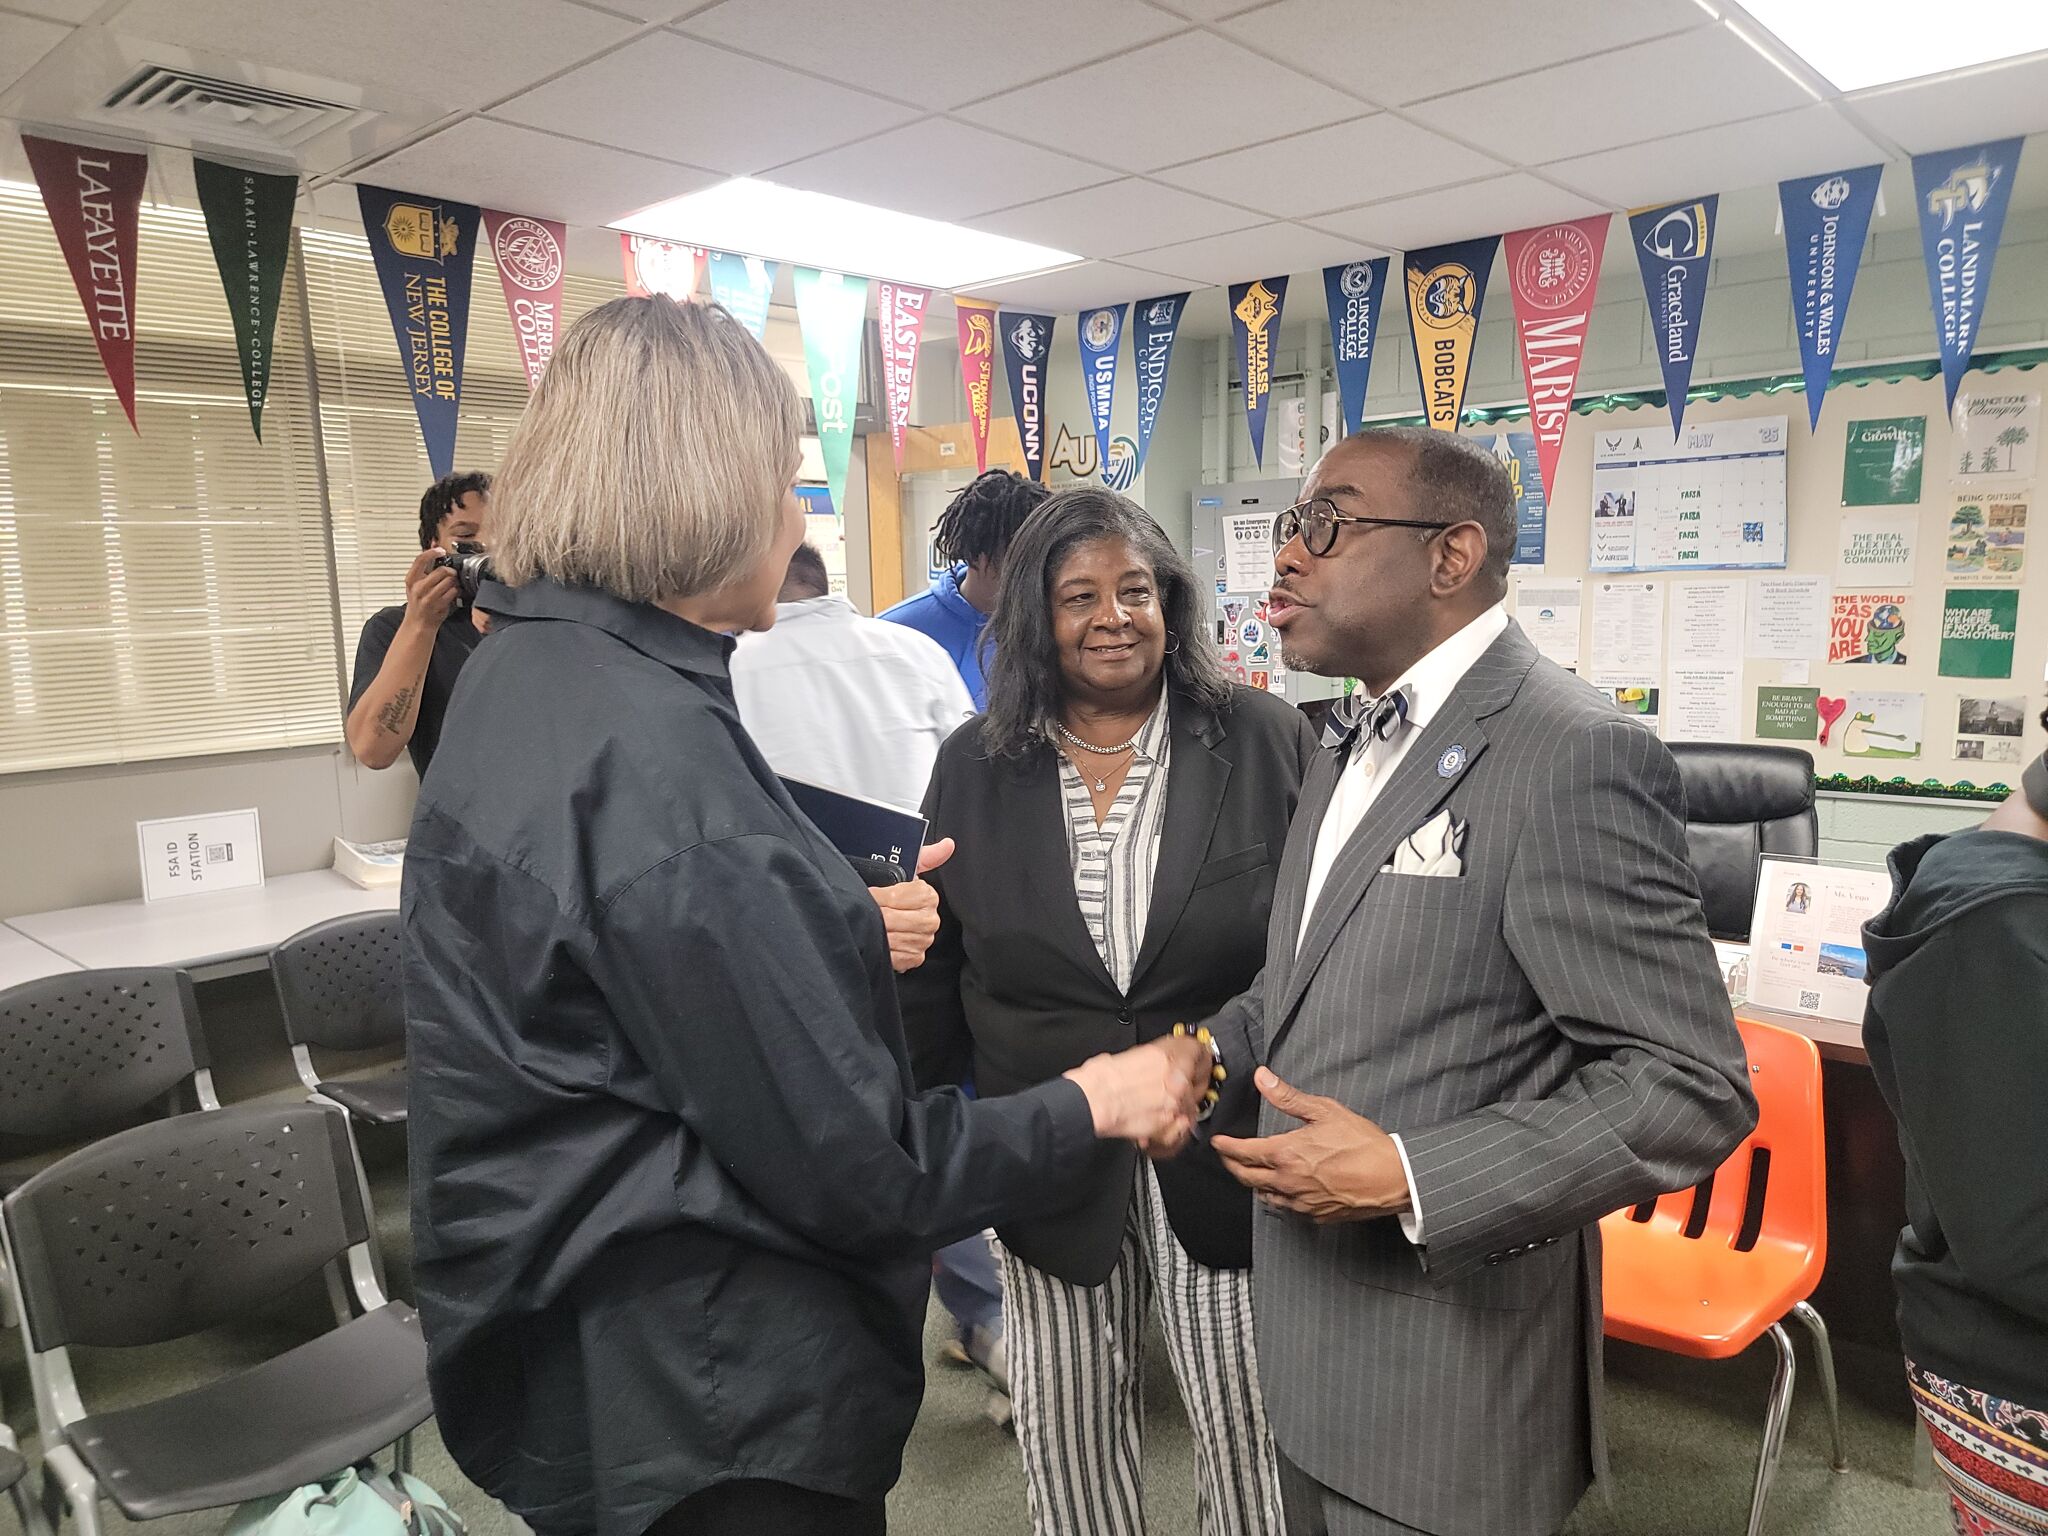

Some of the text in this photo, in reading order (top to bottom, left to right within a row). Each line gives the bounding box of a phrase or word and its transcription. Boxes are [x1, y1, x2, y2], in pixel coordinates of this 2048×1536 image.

[77, 156, 131, 341] LAFAYETTE
[244, 177, 263, 409] SARAH LAWRENCE COLLEGE
[1804, 234, 1820, 339] UNIVERSITY
[1816, 214, 1840, 356] JOHNSON & WALES
[1937, 237, 1957, 347] COLLEGE
[1957, 220, 1984, 357] LANDMARK
[404, 271, 433, 400] NEW JERSEY
[425, 276, 456, 401] THE COLLEGE OF
[1346, 299, 1358, 361] COLLEGE
[1358, 296, 1370, 359] LINCOLN
[1666, 265, 1689, 364] Graceland
[894, 288, 925, 428] EASTERN
[1247, 330, 1257, 410] DARTMOUTH
[1256, 329, 1269, 396] UMASS
[1434, 338, 1456, 422] BOBCATS
[1522, 311, 1587, 447] MARIST
[1022, 364, 1040, 461] UCONN
[1095, 355, 1115, 431] USMMA
[1050, 422, 1097, 477] AU
[1688, 433, 1714, 449] MAY
[1957, 492, 2023, 502] BEING OUTSIDE
[1844, 548, 1910, 556] SUPPORTIVE
[1844, 555, 1908, 564] COMMUNITY
[1852, 533, 1903, 541] THE REAL
[1853, 541, 1879, 549] FLEX
[1882, 540, 1891, 548] IS
[1832, 595, 1905, 604] THE WORLD
[1846, 604, 1872, 618] AS
[1945, 608, 1993, 616] WHY ARE
[1962, 616, 1991, 624] HERE
[1828, 639, 1862, 663] ARE
[1831, 617, 1864, 638] YOU
[1943, 631, 2015, 640] EACH OTHER?
[1944, 623, 2000, 632] IF NOT FOR
[1761, 701, 1792, 709] ENOUGH
[1765, 714, 1807, 722] SOMETHING
[166, 842, 180, 878] FSA ID
[188, 832, 203, 881] STATION
[888, 845, 902, 864] DE
